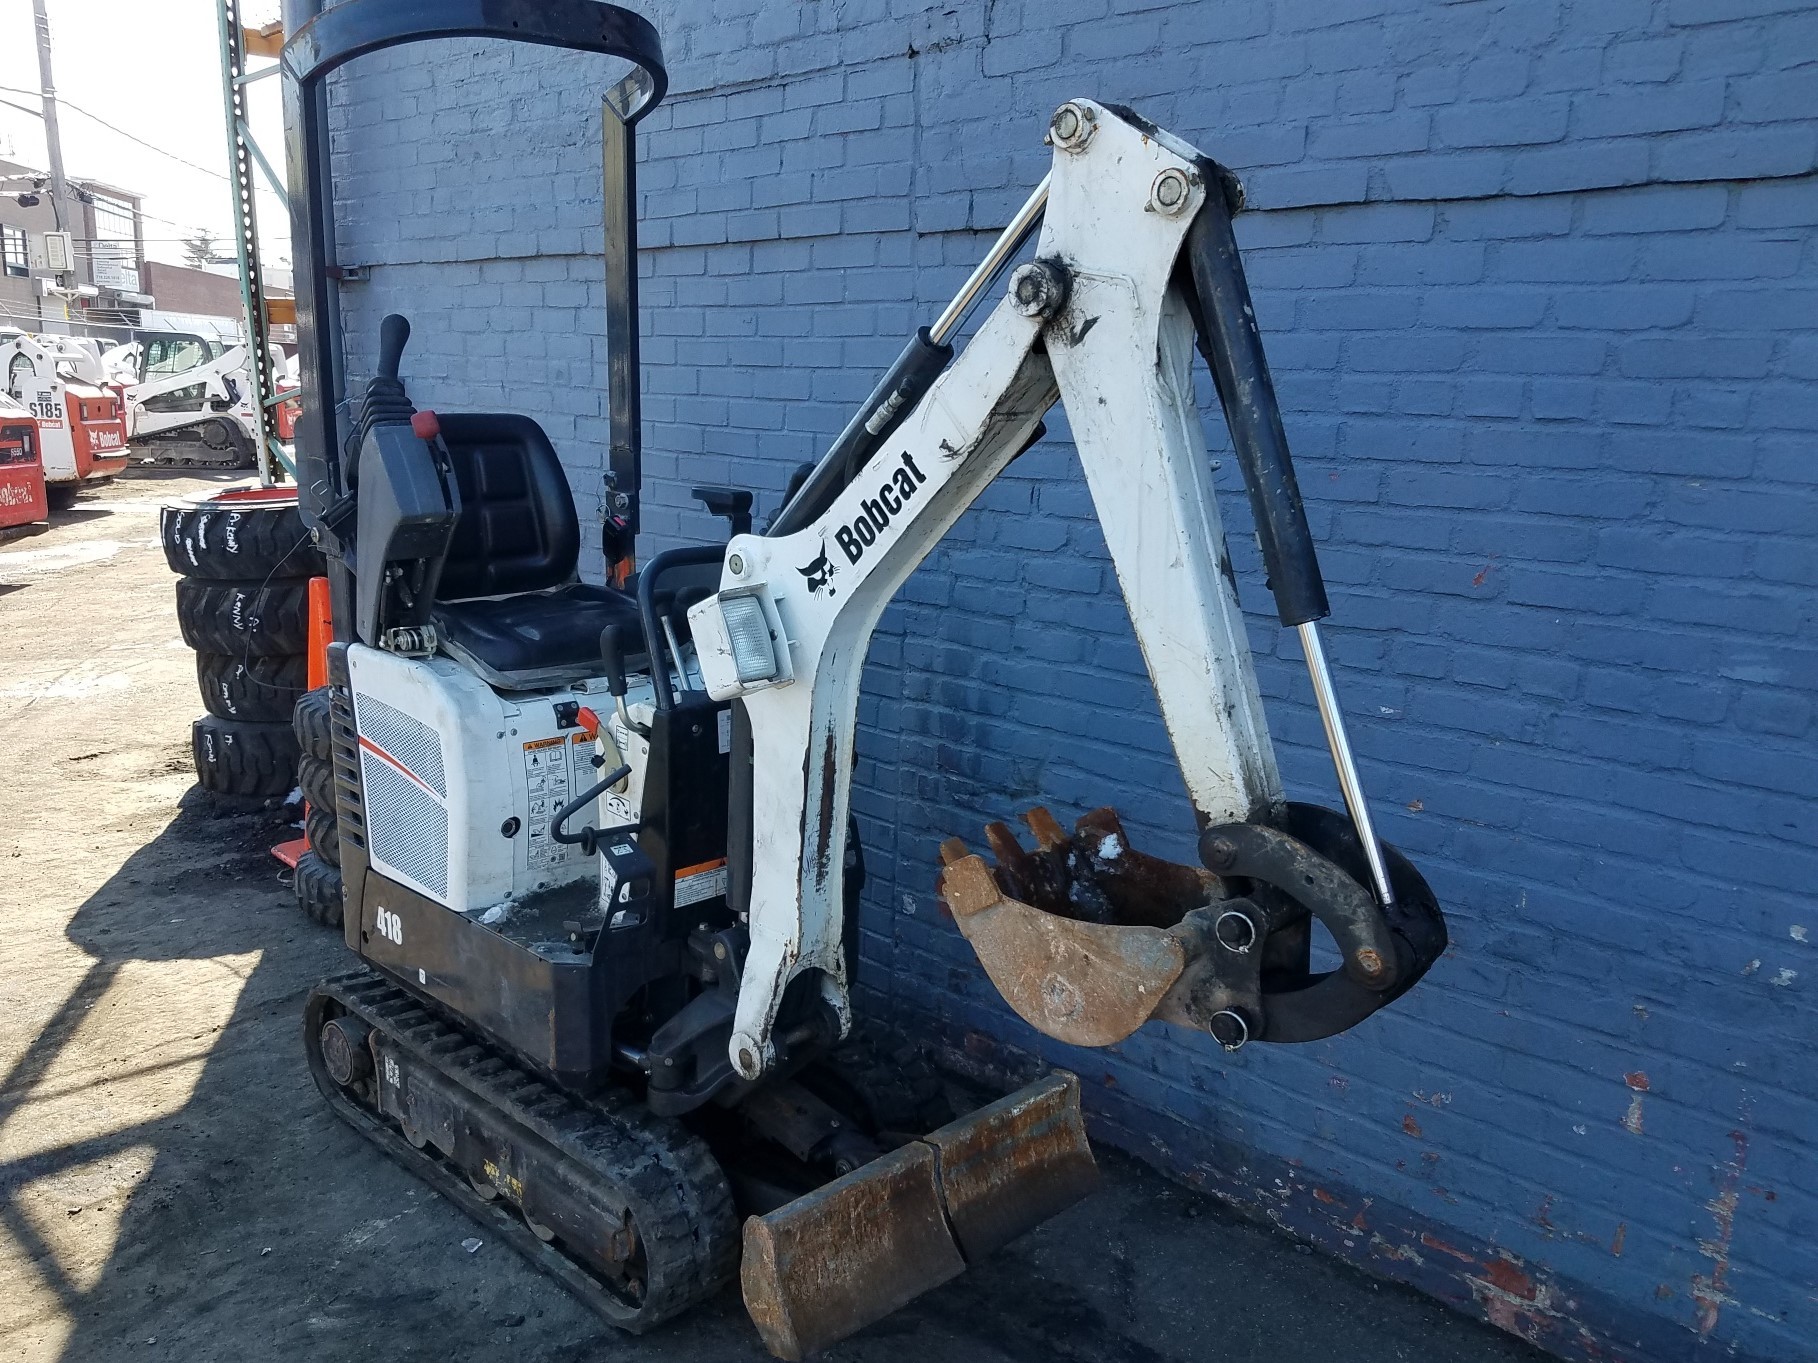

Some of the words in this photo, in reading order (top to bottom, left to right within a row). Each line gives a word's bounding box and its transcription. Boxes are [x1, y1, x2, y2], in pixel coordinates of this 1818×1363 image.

[29, 402, 62, 418] S185
[99, 430, 122, 448] Bobcat
[834, 450, 927, 567] Bobcat
[533, 738, 562, 749] WARNING
[377, 905, 403, 945] 418
